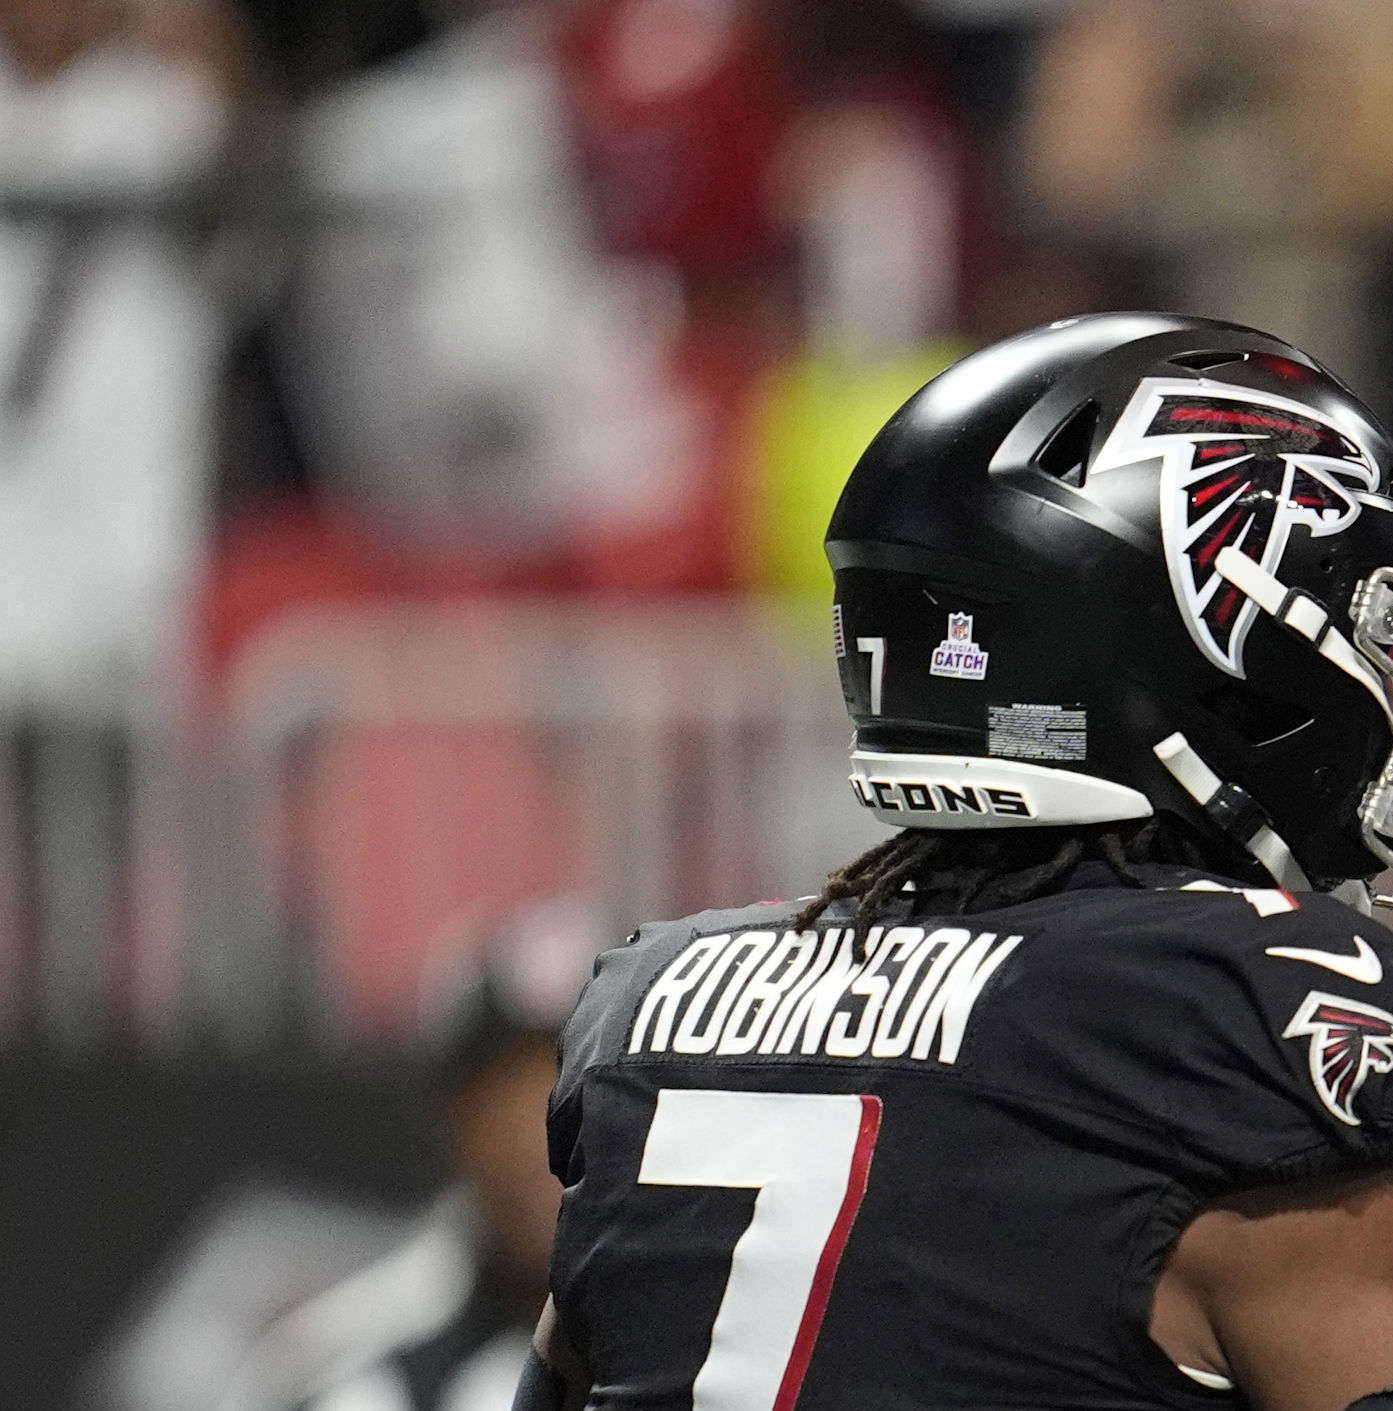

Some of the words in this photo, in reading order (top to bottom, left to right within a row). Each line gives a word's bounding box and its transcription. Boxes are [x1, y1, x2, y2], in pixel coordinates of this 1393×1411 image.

[856, 637, 888, 716] 7
[934, 651, 985, 671] CATCH
[1011, 703, 1063, 711] WARNING
[627, 926, 1024, 1065] ROBINSON
